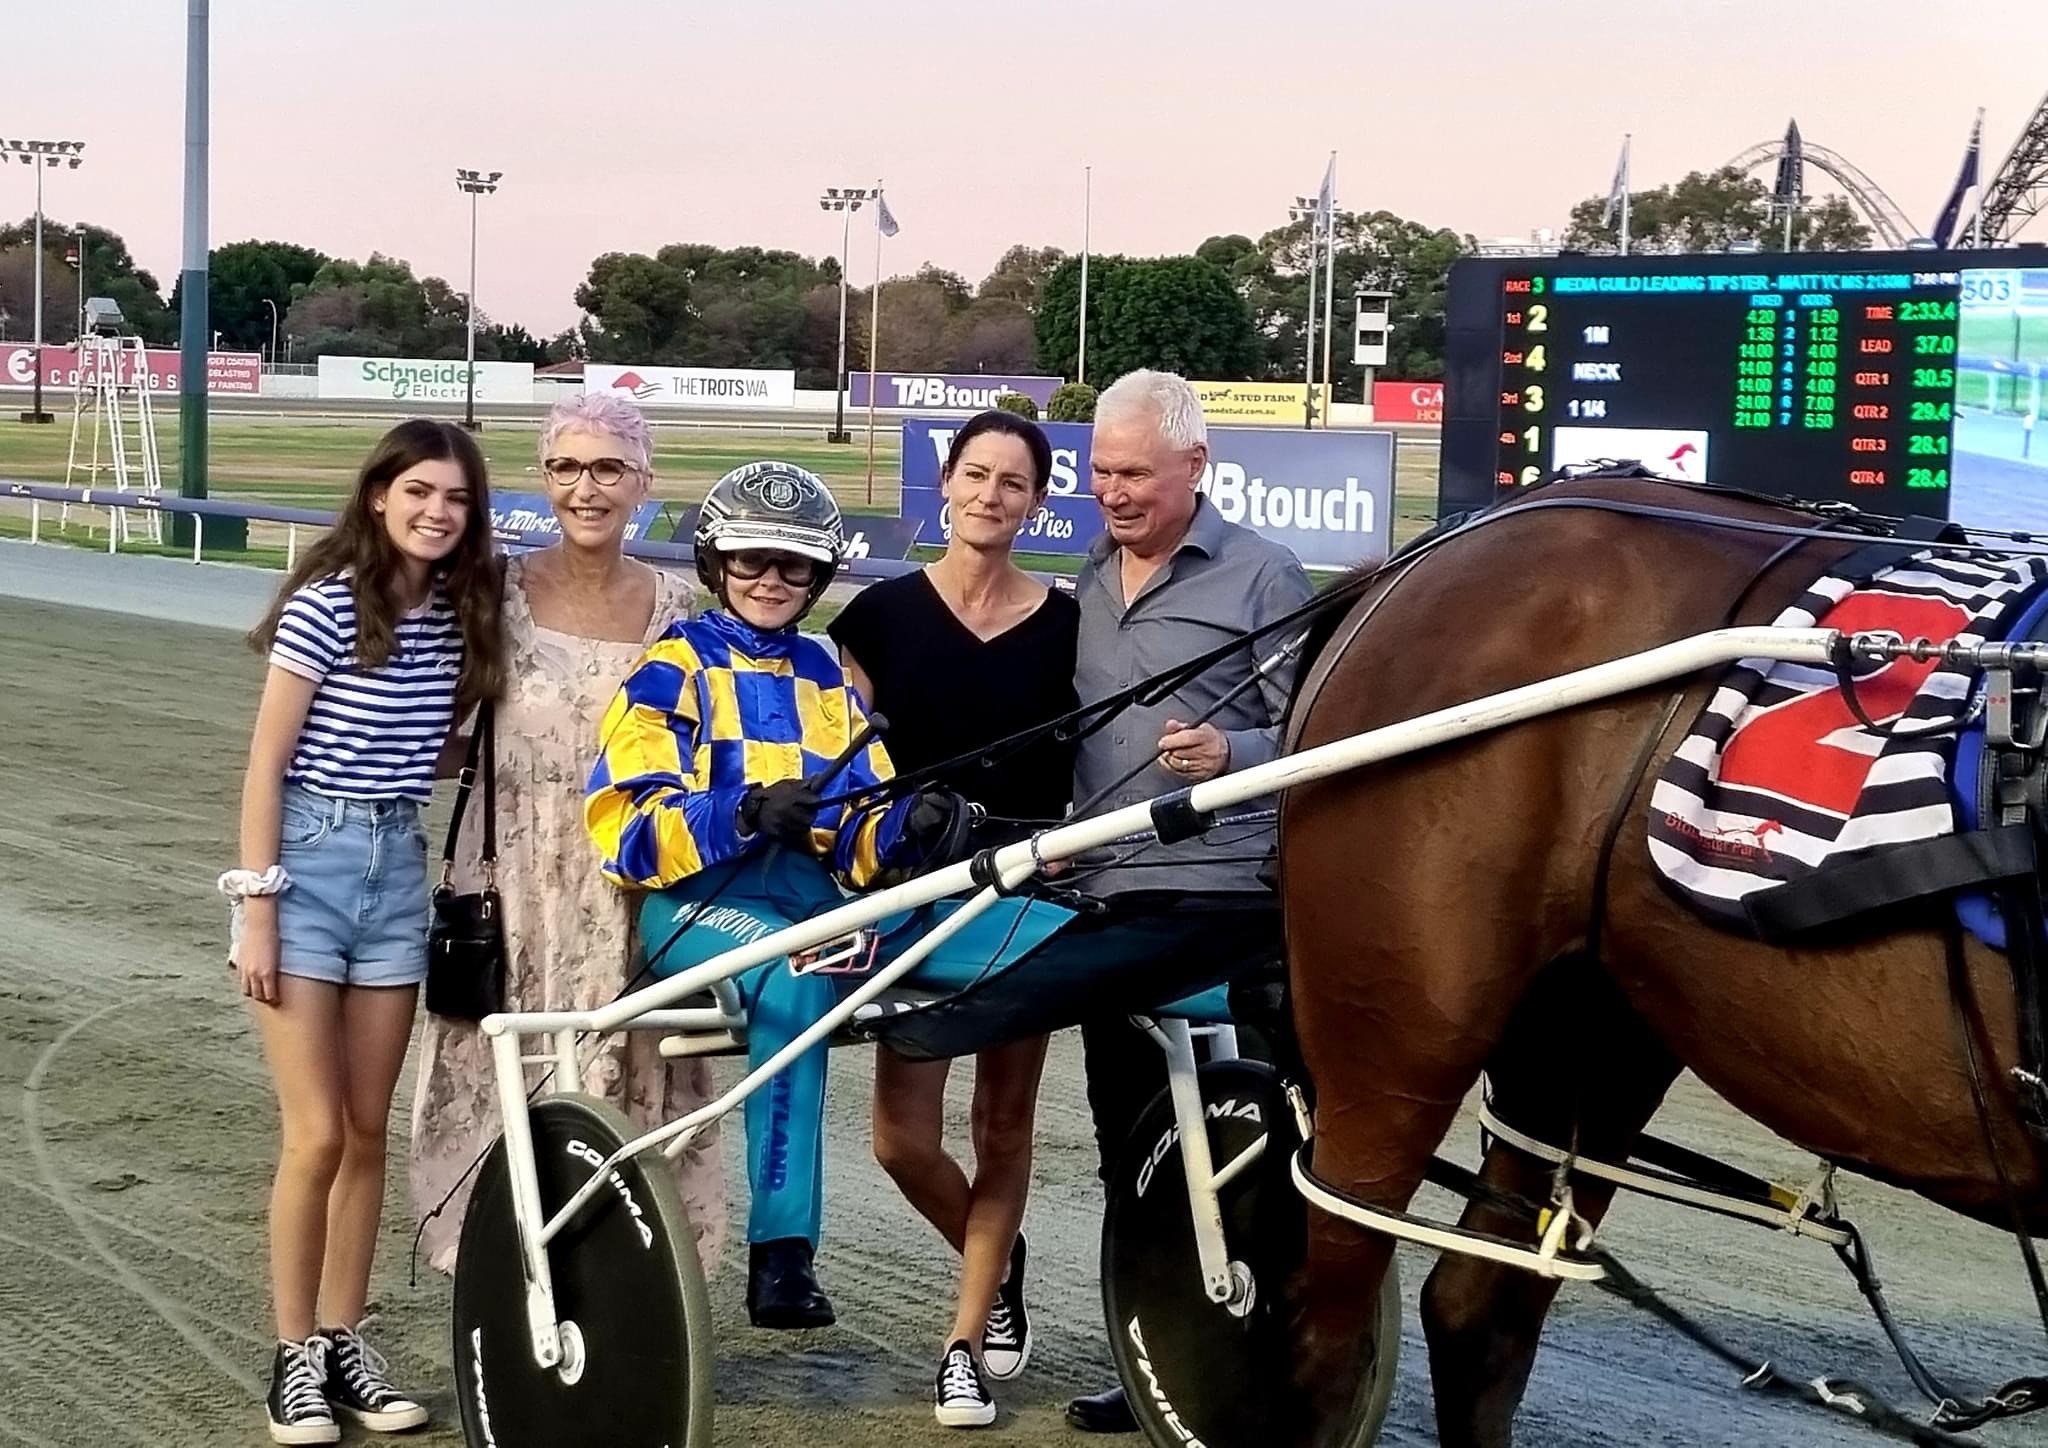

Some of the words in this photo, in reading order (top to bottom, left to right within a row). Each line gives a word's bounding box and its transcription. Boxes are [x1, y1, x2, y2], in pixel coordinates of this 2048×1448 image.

[1506, 280, 1531, 293] RACE
[1532, 277, 1545, 294] 3
[1643, 275, 1705, 291] LEADING
[1707, 275, 1769, 291] TIPSTER
[1963, 280, 2010, 300] 503
[1528, 305, 1548, 331] 2
[1810, 309, 1839, 324] 1.50
[1866, 307, 1893, 320] TIME
[1900, 302, 1956, 321] 2:33.4
[1783, 327, 1795, 341] 2
[1809, 327, 1838, 342] 1.12
[1783, 344, 1794, 358] 3
[1808, 344, 1837, 359] 4.00
[1861, 339, 1892, 353] LEAD
[1914, 335, 1955, 354] 37.0
[1526, 345, 1546, 371] 4
[362, 361, 484, 384] Schneider
[1573, 362, 1621, 381] NECK
[1807, 361, 1836, 376] 4.00
[1806, 378, 1835, 394] 4.00
[1914, 369, 1953, 388] 30.5
[412, 385, 483, 399] Electrc
[1233, 393, 1262, 402] STUD
[1264, 394, 1296, 402] FARM
[1524, 385, 1544, 412] 3
[1911, 401, 1950, 421] 29.4
[1524, 425, 1541, 452] 1
[1908, 435, 1949, 454] 28.1
[1907, 468, 1948, 488] 28.4
[1029, 507, 1074, 539] Pies
[1137, 1099, 1262, 1197] COMA
[567, 1139, 653, 1249] COIMA
